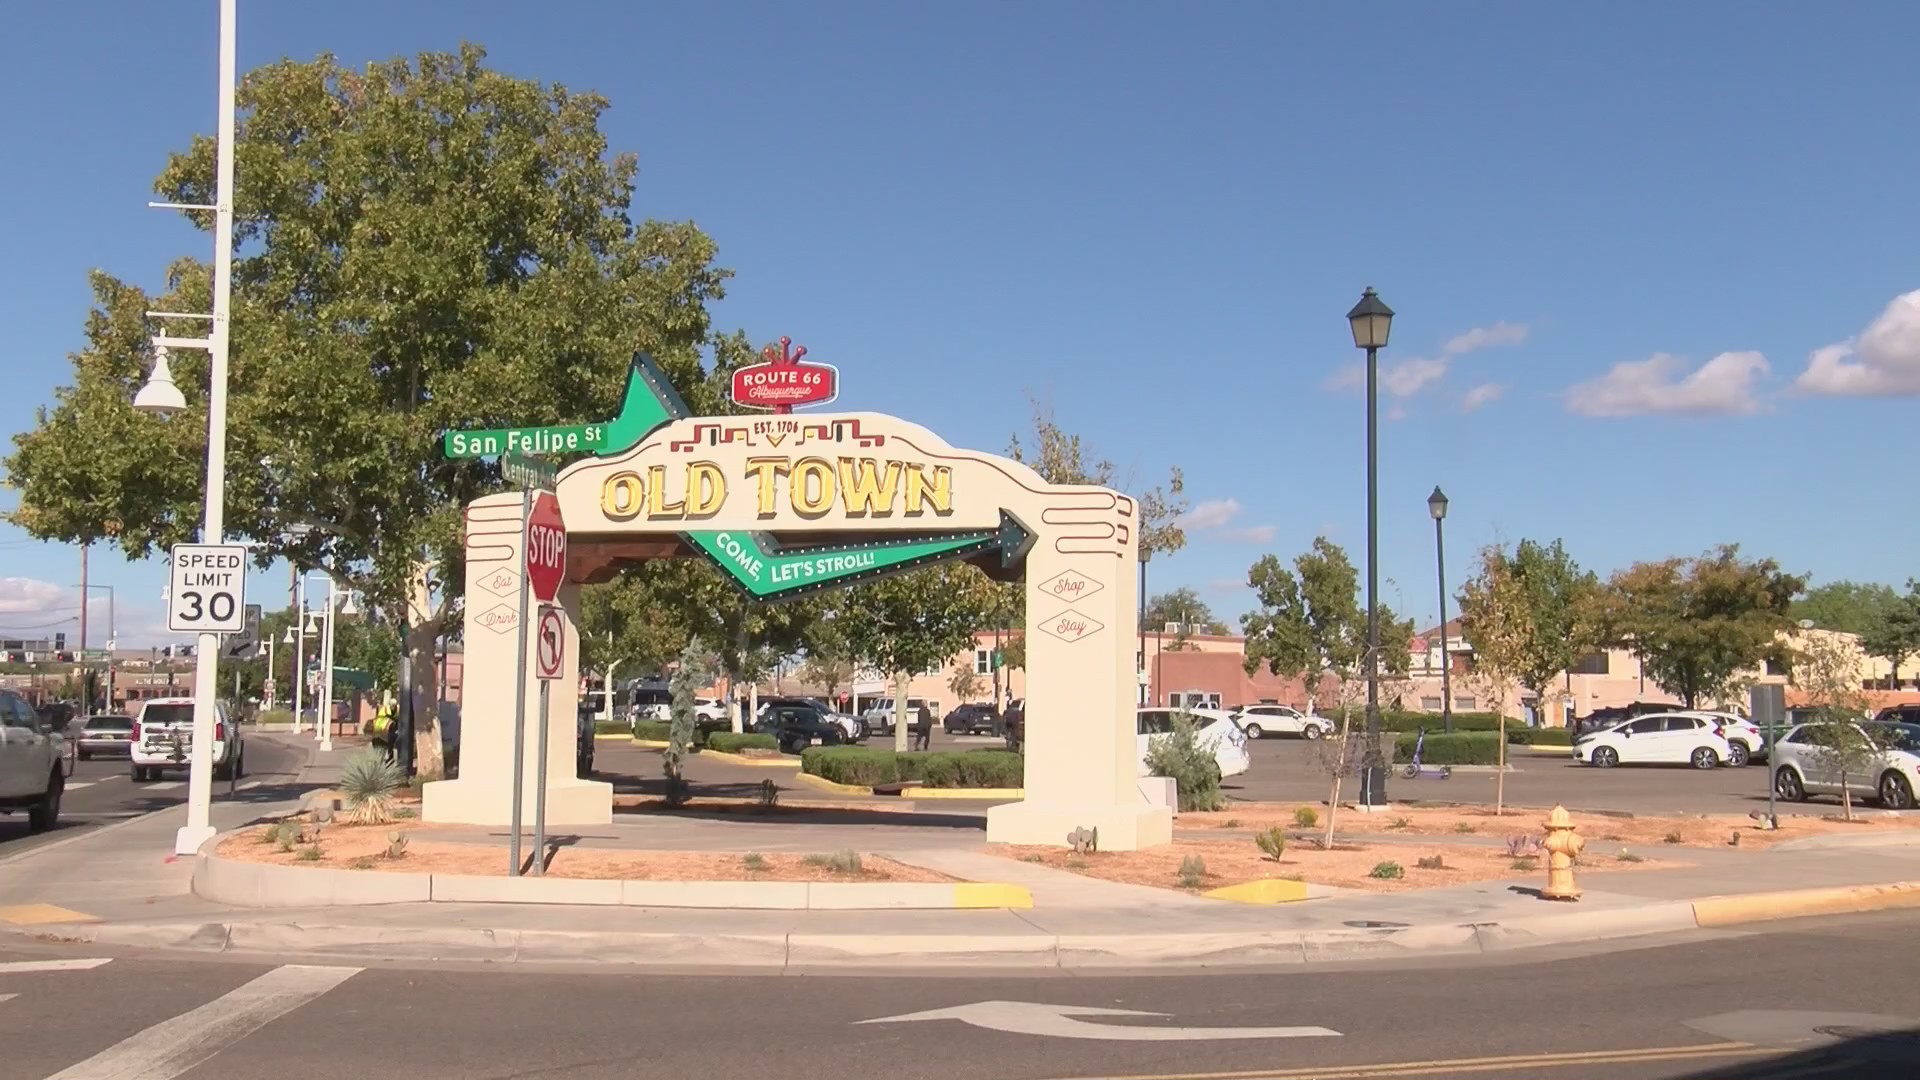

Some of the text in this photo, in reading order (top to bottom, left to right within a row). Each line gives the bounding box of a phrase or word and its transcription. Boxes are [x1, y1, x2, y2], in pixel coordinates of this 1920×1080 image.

[743, 372, 821, 386] ROUTE 66
[749, 386, 812, 399] Albuquerque
[777, 421, 799, 433] 1706
[452, 427, 602, 454] San Felipe St
[600, 456, 953, 521] OLD TOWN
[529, 524, 564, 568] STOP
[178, 554, 240, 568] SPEED
[716, 532, 763, 582] COME,
[771, 552, 875, 583] LET'S STROLL!
[184, 572, 232, 586] LIMIT
[492, 576, 513, 590] Eat
[1053, 577, 1085, 596] Shop
[178, 591, 235, 621] 30
[486, 610, 518, 628] Drink
[1056, 618, 1087, 636] Stay
